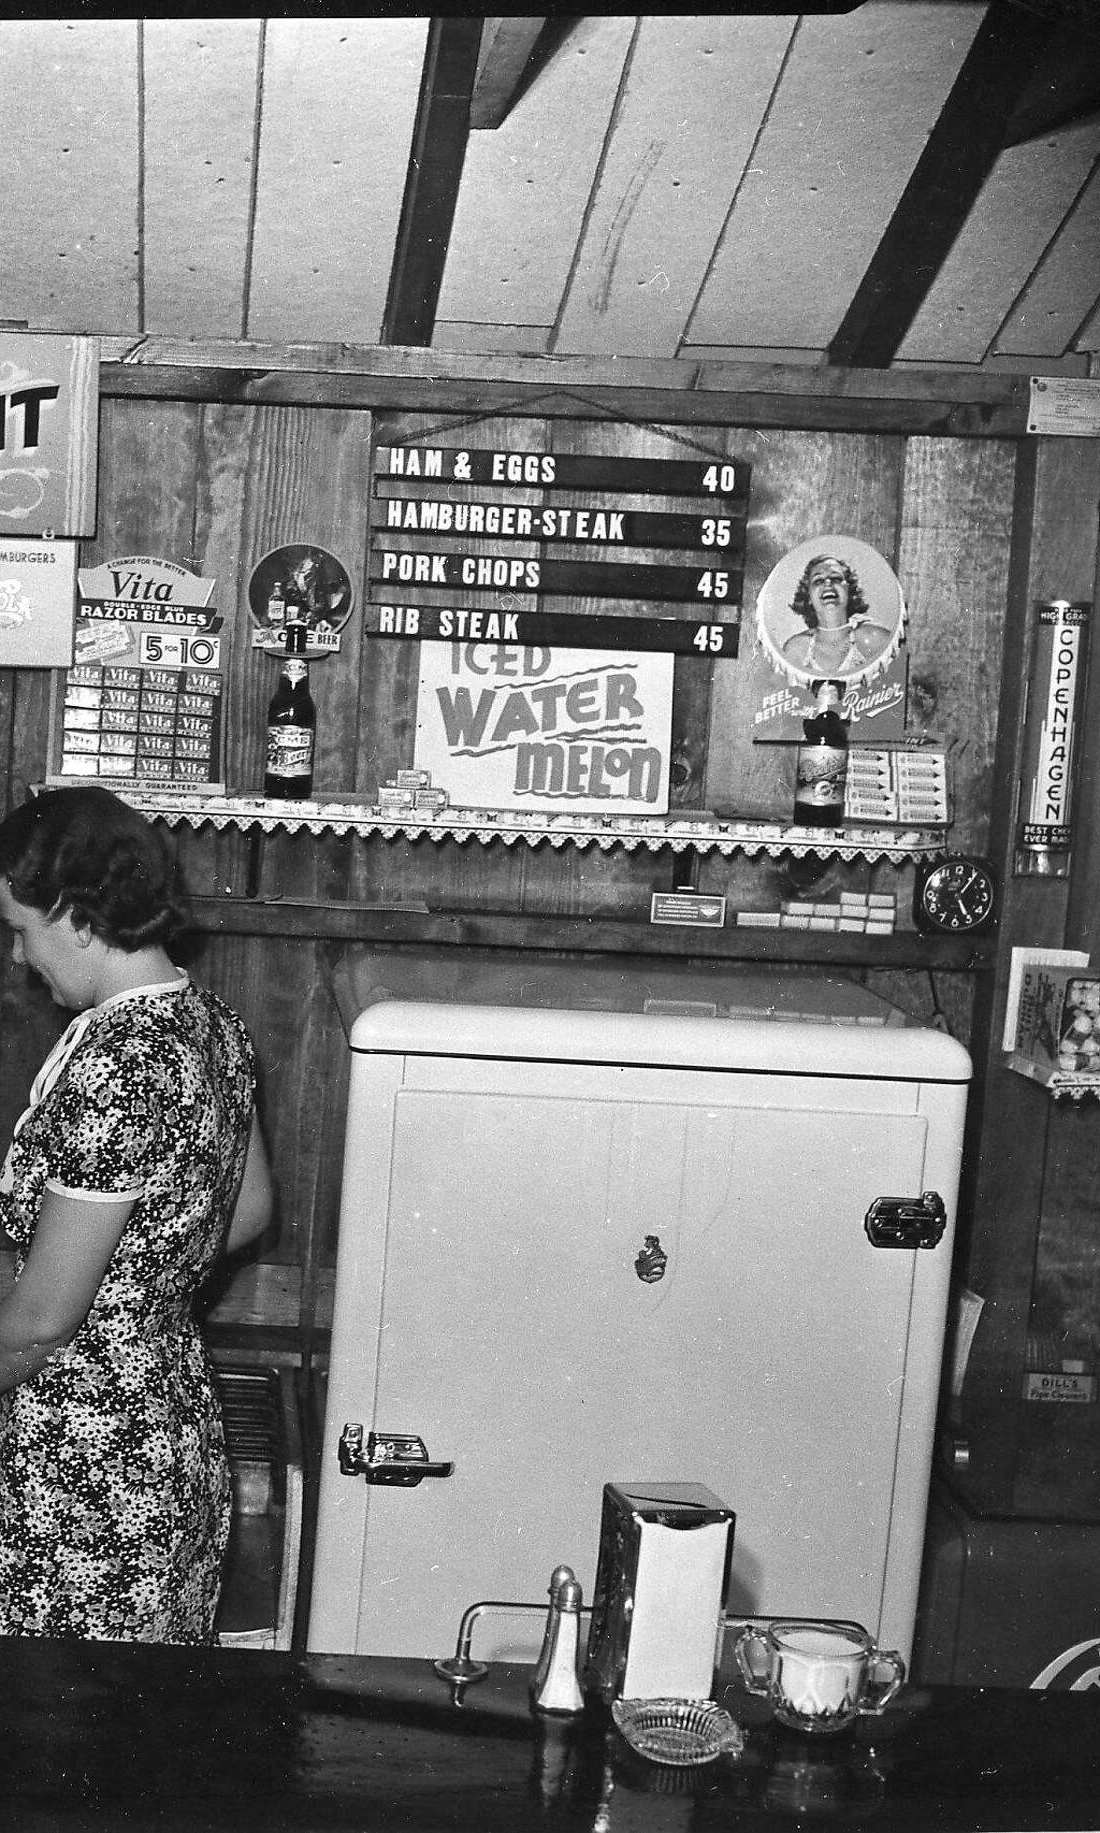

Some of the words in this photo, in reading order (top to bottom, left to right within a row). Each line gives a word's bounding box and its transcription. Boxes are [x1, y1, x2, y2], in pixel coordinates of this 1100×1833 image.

[389, 447, 443, 478] HAM
[453, 451, 472, 480] &
[492, 453, 556, 483] EGGS
[702, 465, 735, 492] 40
[701, 519, 731, 547] 35
[383, 553, 447, 583] PORK
[462, 557, 541, 588] CHOPS
[697, 572, 729, 598] 45
[110, 570, 174, 602] Vita
[80, 605, 138, 621] RAZOR
[142, 610, 207, 626] BLADES
[379, 606, 420, 635] RIB
[438, 611, 519, 641] STEAK
[693, 625, 724, 651] 45
[317, 634, 338, 645] BEER
[146, 636, 163, 662] 5
[451, 642, 551, 677] ICED
[111, 669, 136, 682] Vita
[150, 671, 175, 685] Vita
[192, 674, 217, 688] Vita
[110, 691, 135, 704] Vita
[148, 692, 173, 706] Vita
[184, 695, 211, 708] Vita
[763, 688, 792, 709] FEEL
[840, 683, 904, 722] Rainier
[436, 673, 644, 746] WATER
[754, 697, 800, 724] BETTER
[146, 715, 171, 728] Vita
[183, 718, 209, 732] Vita
[1045, 629, 1074, 820] COPENHAGEN
[144, 737, 170, 750] Vita
[182, 740, 208, 753] Vita
[142, 759, 167, 772] Vita
[179, 762, 206, 776] Vita
[145, 782, 198, 791] GUARANTEED
[1025, 826, 1048, 834] BEST
[1024, 835, 1048, 843] EVER
[980, 879, 986, 888] 2
[929, 903, 937, 913] 8
[975, 905, 983, 914] 4
[939, 911, 948, 922] 7
